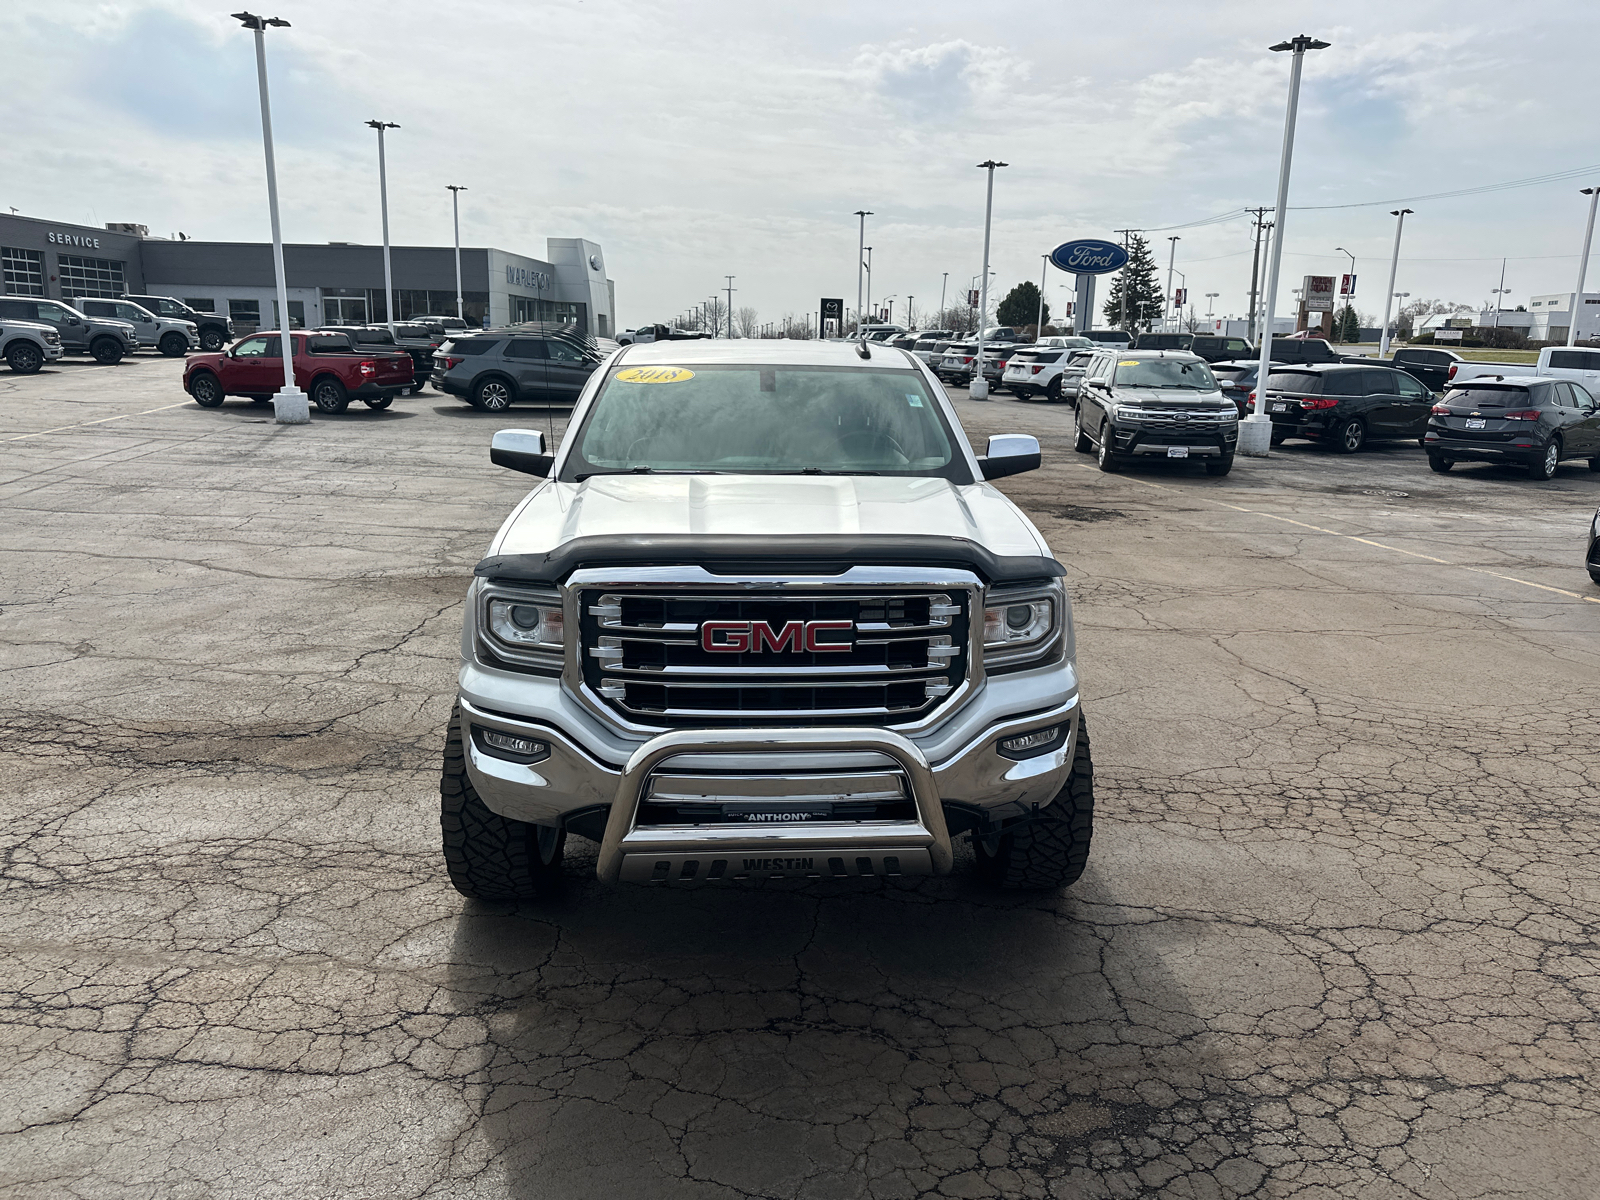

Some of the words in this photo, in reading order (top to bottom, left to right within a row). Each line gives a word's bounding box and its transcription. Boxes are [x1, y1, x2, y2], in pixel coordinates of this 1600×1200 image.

[48, 231, 100, 249] SERVICE
[1068, 245, 1115, 267] Ford
[626, 369, 683, 380] 2018
[701, 620, 853, 653] GMC
[748, 812, 808, 821] ANTHONY
